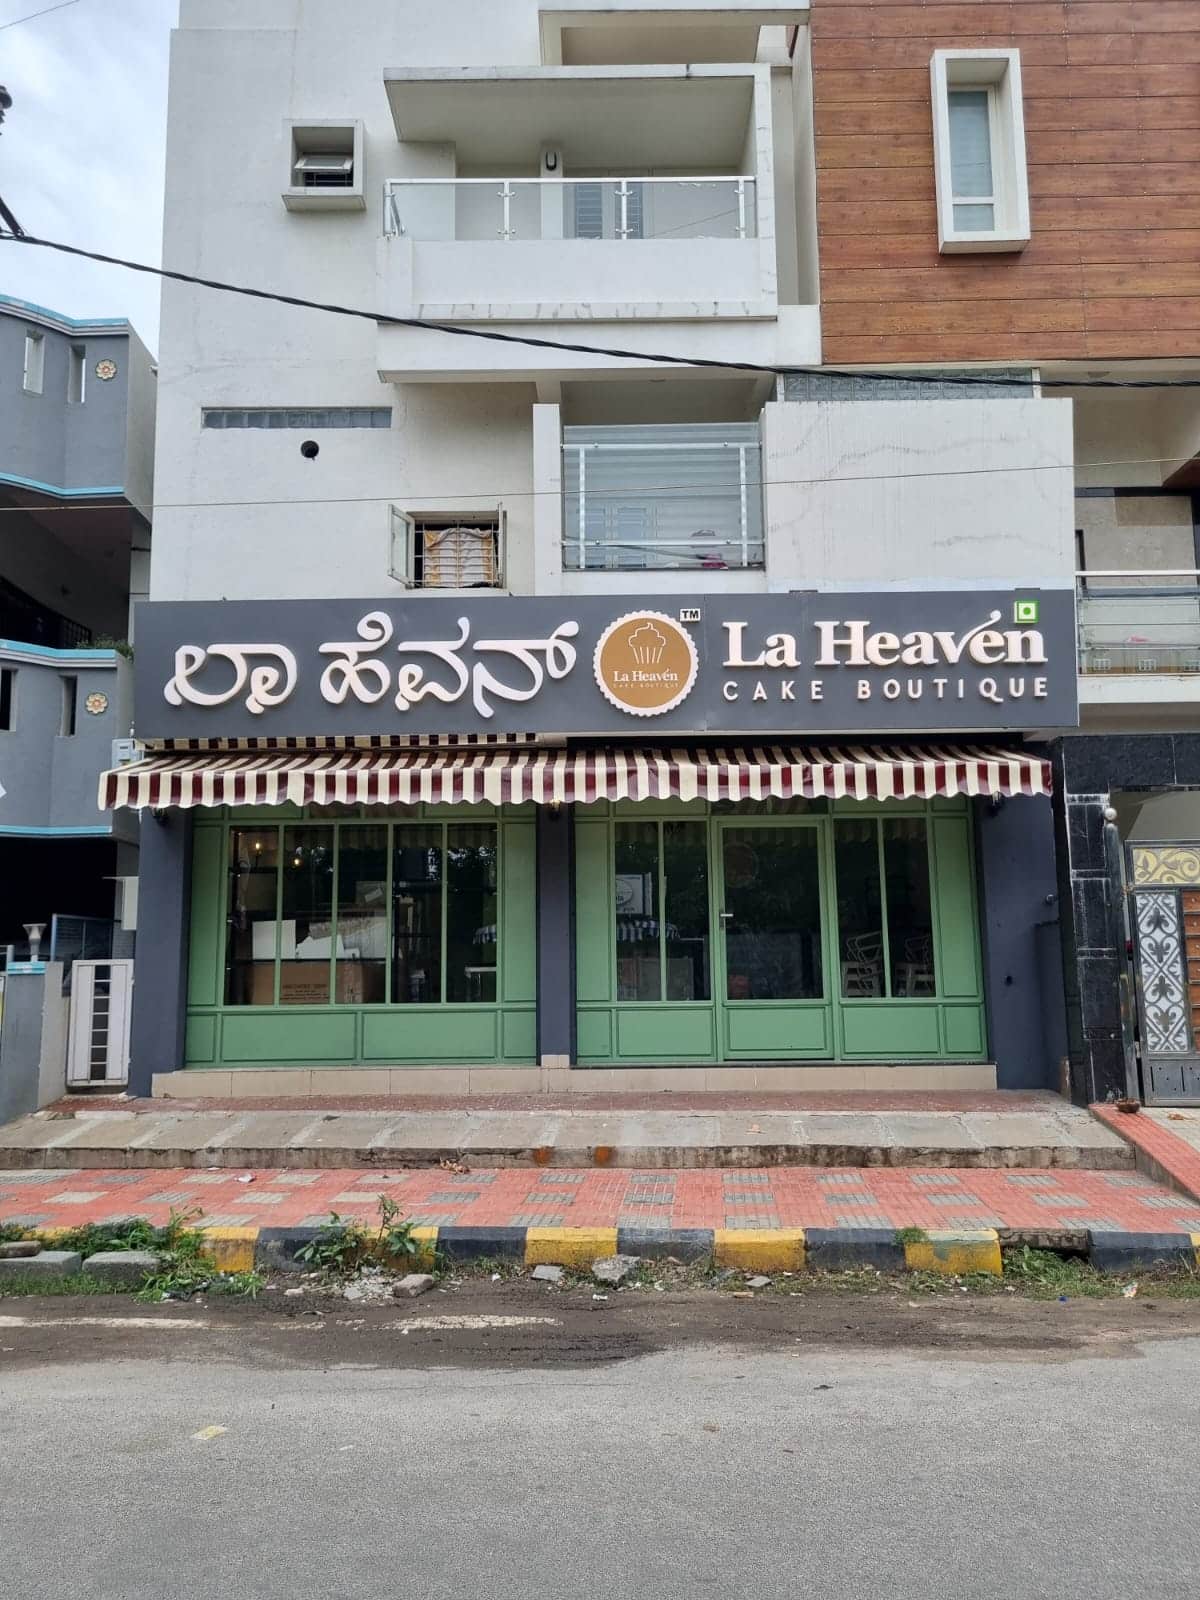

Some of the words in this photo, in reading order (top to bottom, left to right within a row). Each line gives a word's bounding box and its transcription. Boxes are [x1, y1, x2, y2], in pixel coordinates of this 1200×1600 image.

[682, 610, 699, 619] TM
[722, 621, 802, 668] La
[163, 643, 298, 714] ಲಾ
[613, 670, 629, 682] La
[722, 680, 824, 701] CAKE
[857, 676, 1049, 703] BOUTIQUE
